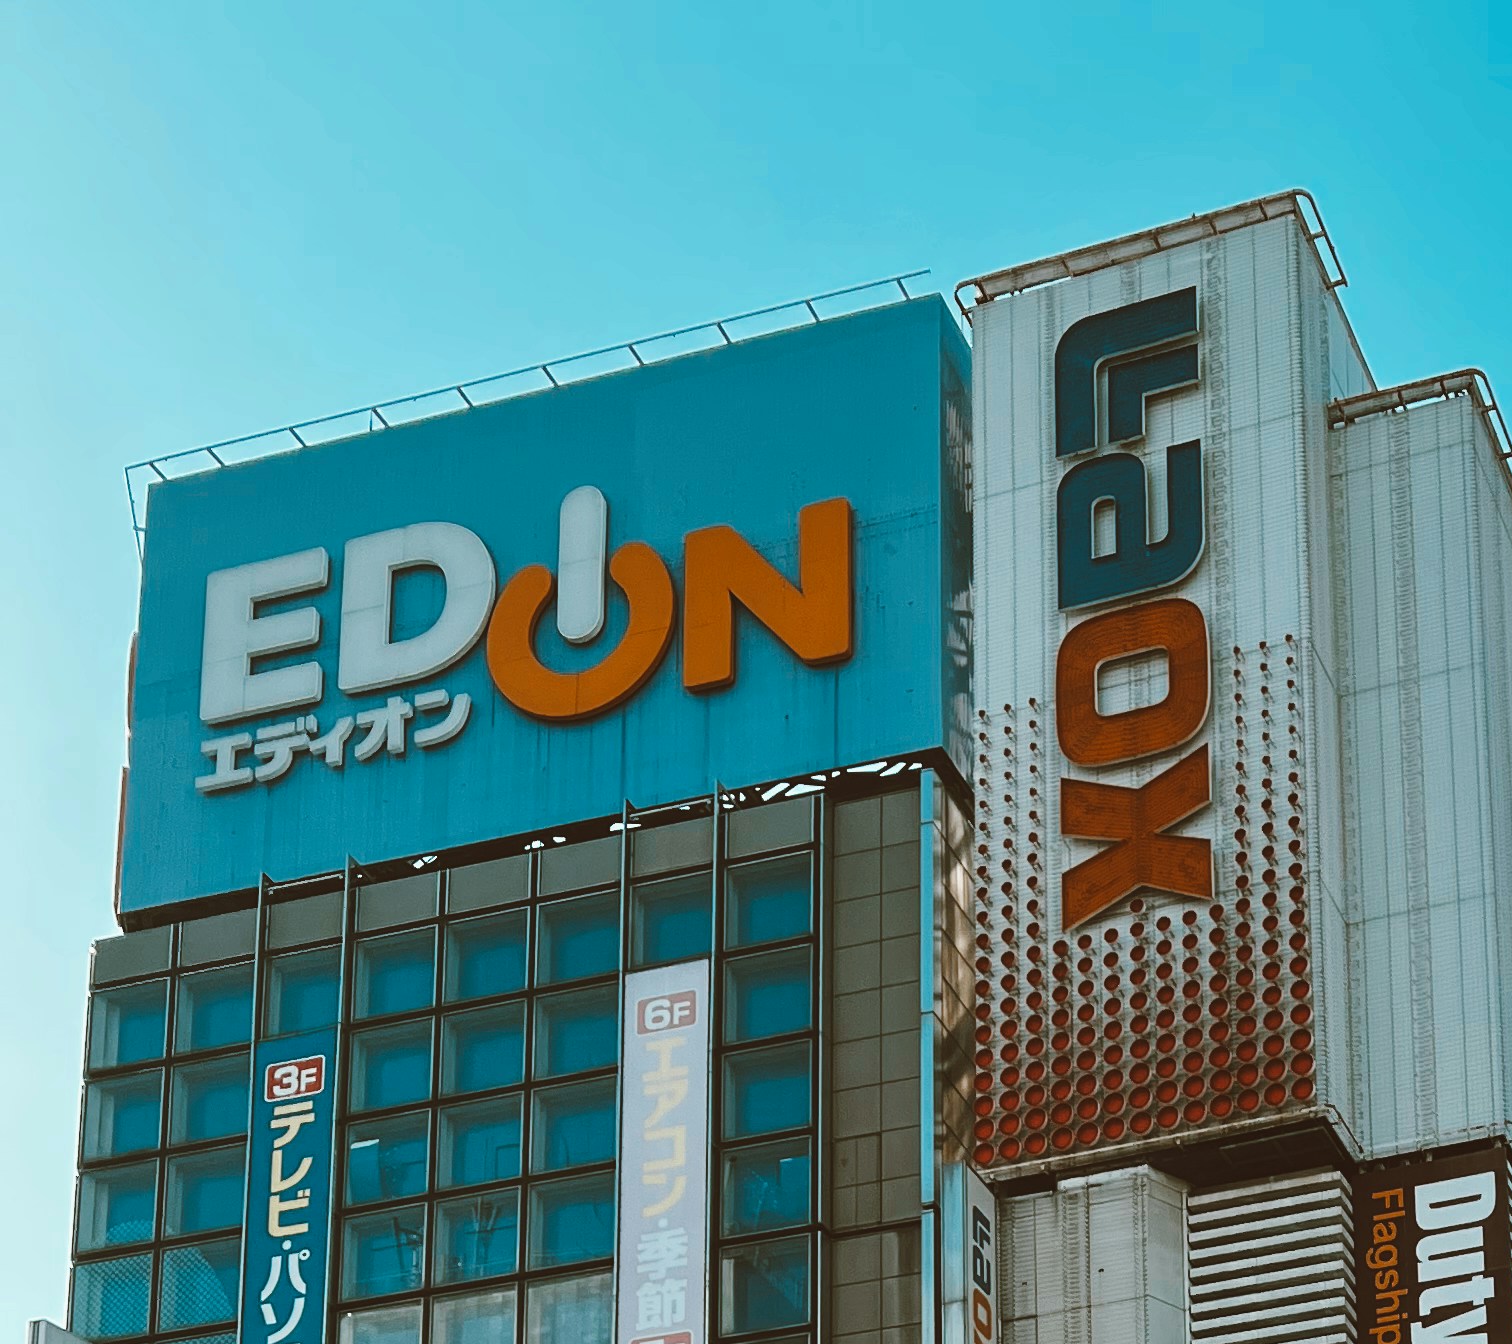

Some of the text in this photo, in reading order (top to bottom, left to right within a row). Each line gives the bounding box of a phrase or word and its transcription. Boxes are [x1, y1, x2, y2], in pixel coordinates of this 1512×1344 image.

[200, 484, 853, 722] EDION
[194, 688, 473, 792] エディオン
[644, 998, 691, 1031] 6F
[272, 1063, 318, 1097] 3F
